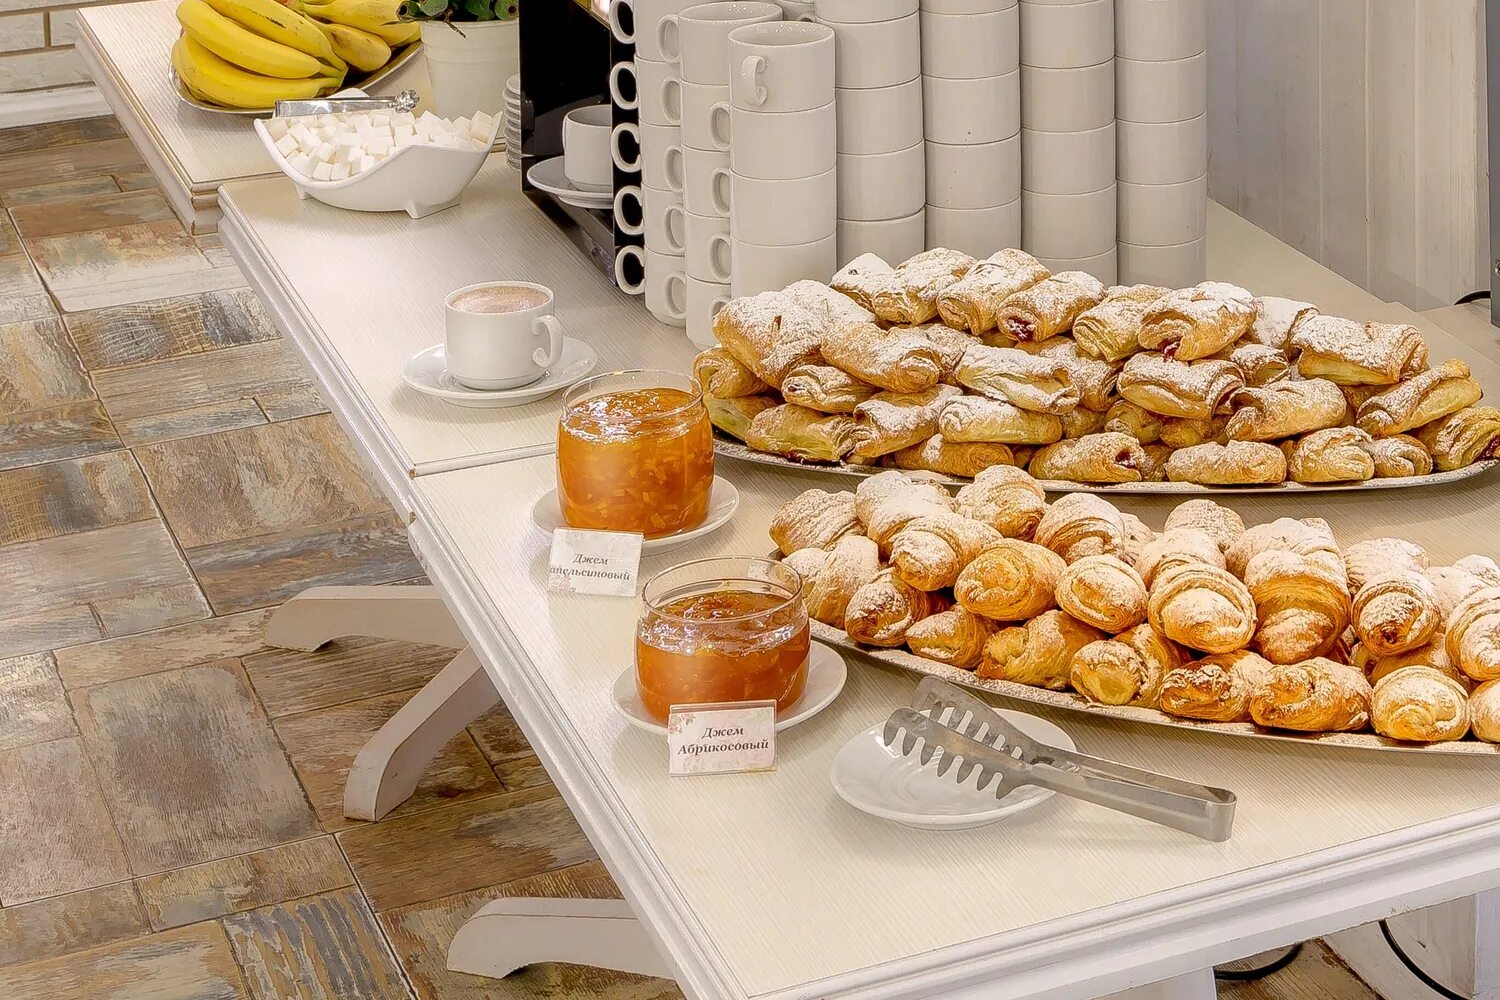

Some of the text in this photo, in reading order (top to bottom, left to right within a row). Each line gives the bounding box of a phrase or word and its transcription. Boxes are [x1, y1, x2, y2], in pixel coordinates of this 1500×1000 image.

[573, 553, 609, 565] Джем
[702, 727, 744, 740] Джем
[677, 739, 769, 756] Абрикосовый
